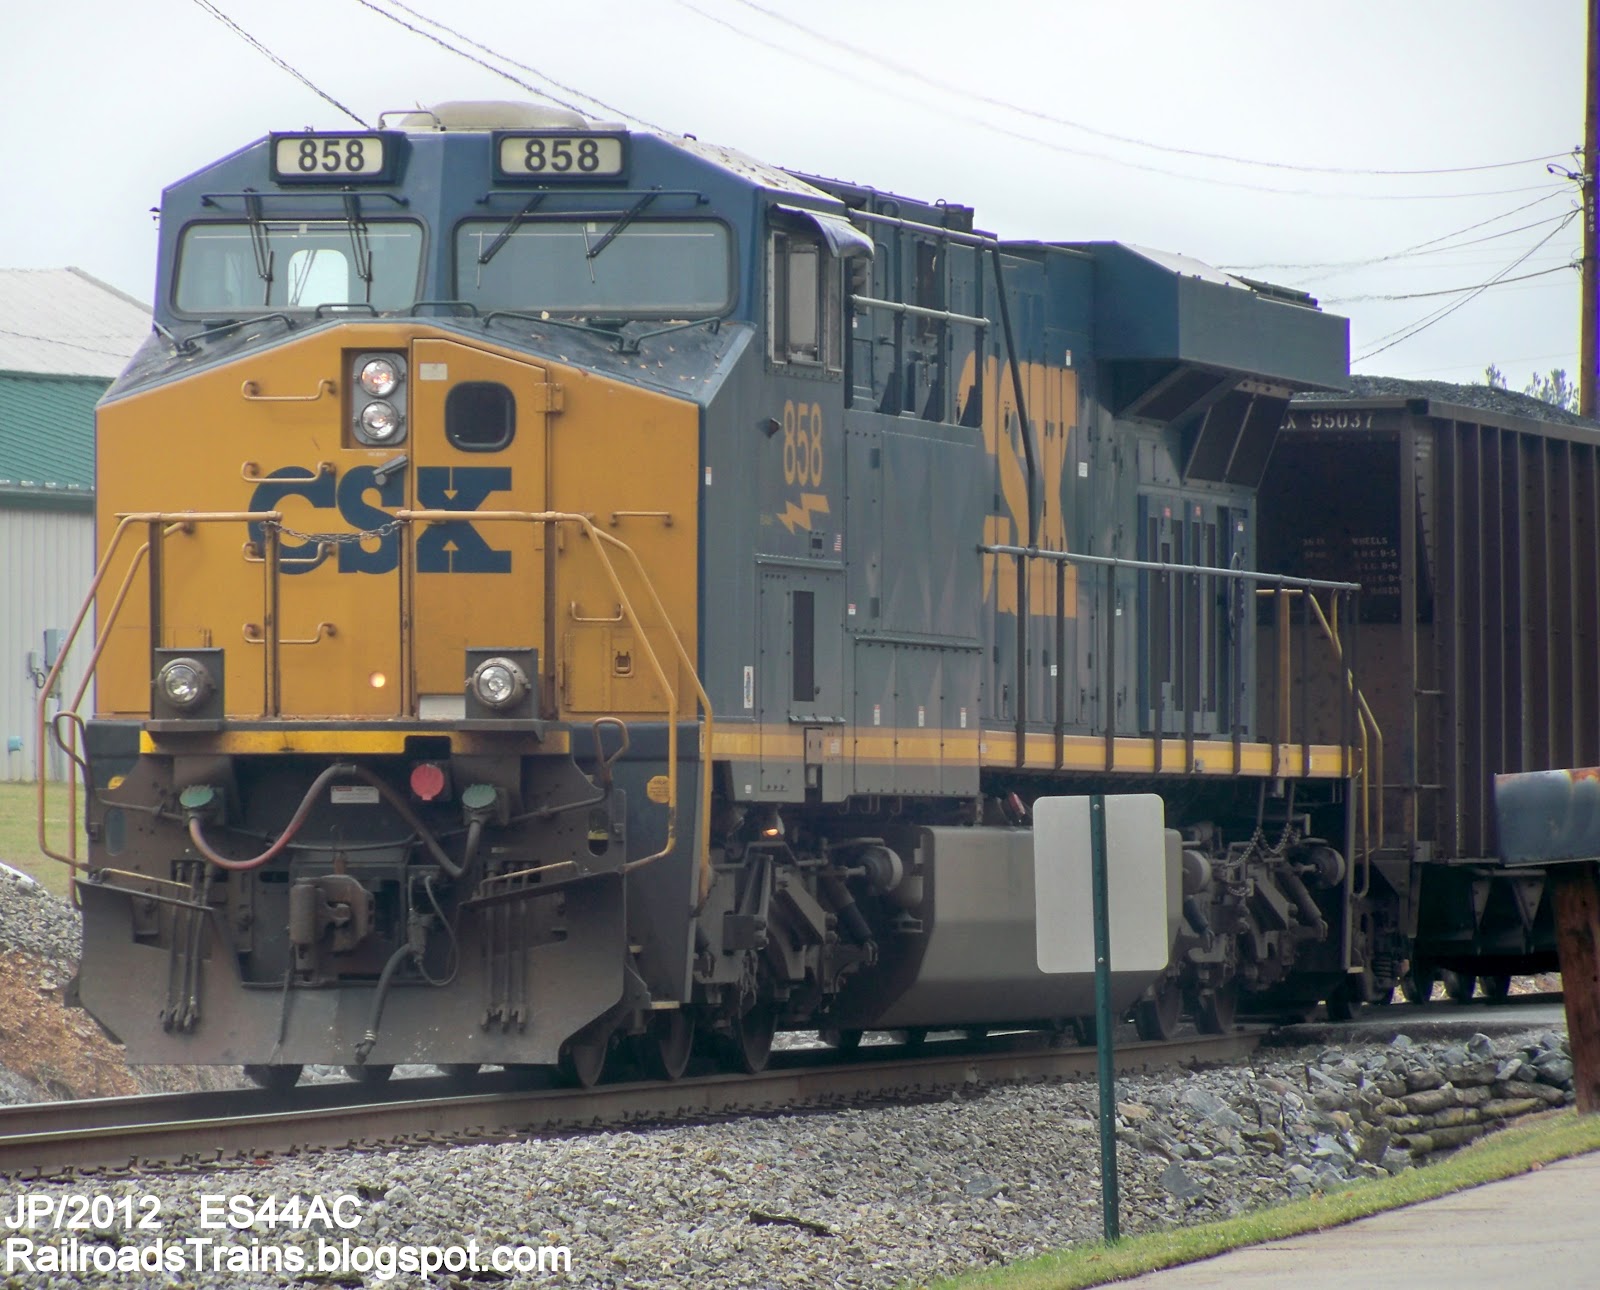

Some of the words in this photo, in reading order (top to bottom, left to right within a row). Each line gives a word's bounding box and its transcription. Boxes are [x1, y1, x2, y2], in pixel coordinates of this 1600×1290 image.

[298, 139, 365, 172] 858
[524, 139, 600, 172] 858
[1310, 412, 1376, 429] 95037
[782, 399, 822, 488] 858
[248, 465, 512, 575] CSX
